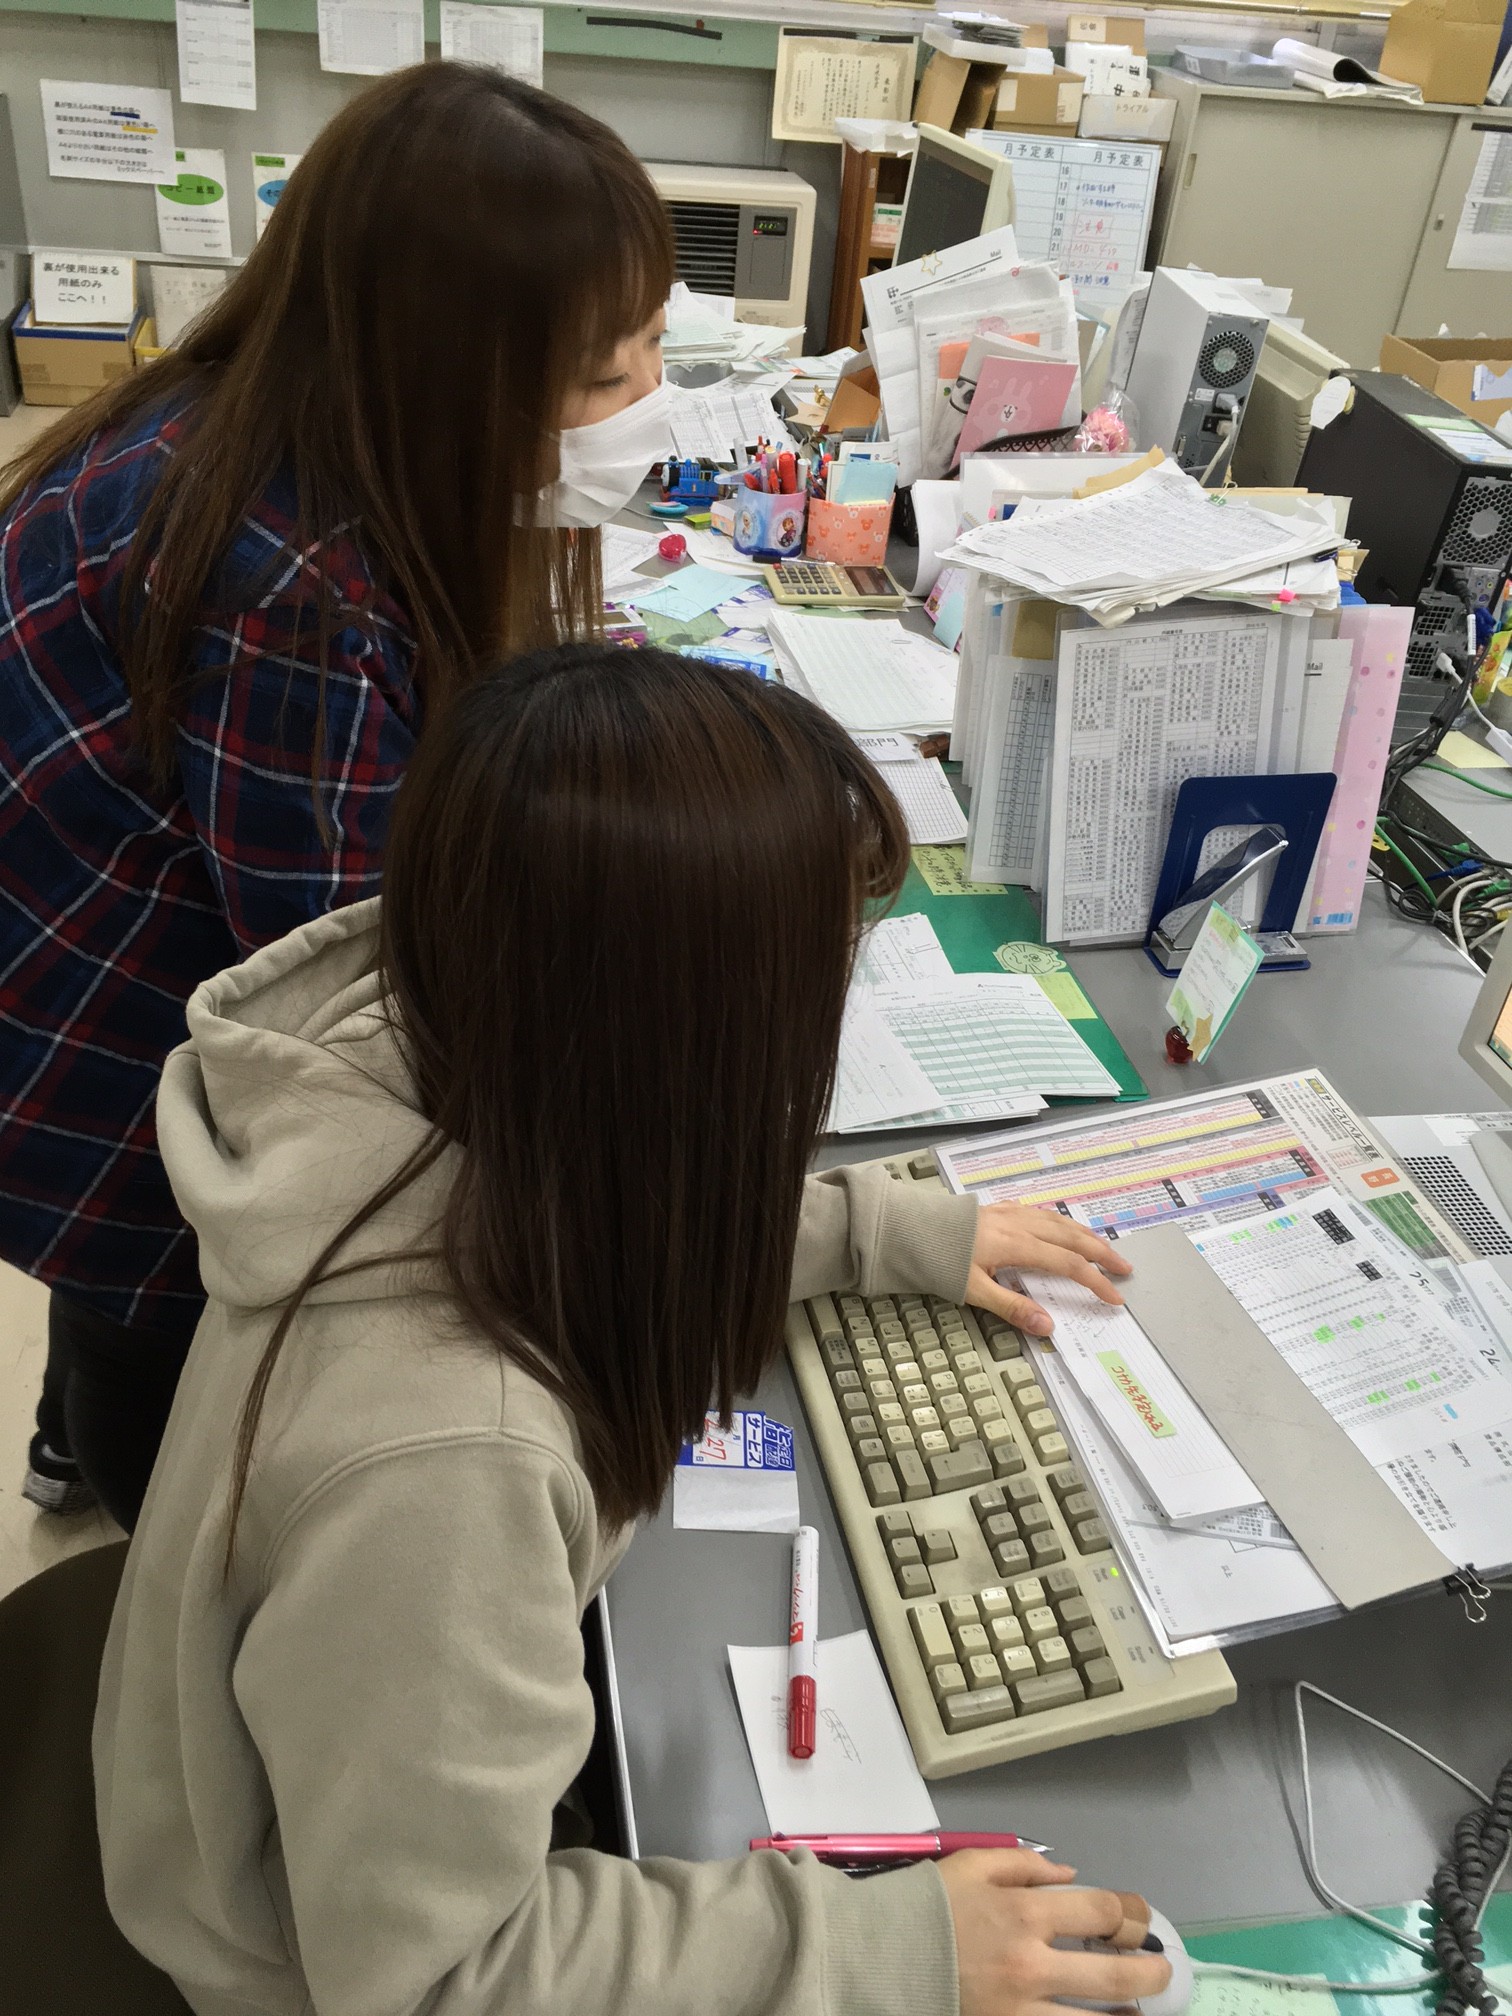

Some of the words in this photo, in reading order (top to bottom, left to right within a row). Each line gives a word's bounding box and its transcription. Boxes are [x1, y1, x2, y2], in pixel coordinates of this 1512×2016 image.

[43, 261, 120, 276] 裏が使用出来る
[58, 277, 103, 288] 用紙のみ
[1322, 1094, 1381, 1159] サービスレベル一覧表
[699, 1437, 727, 1461] 27
[747, 1415, 763, 1465] サービス
